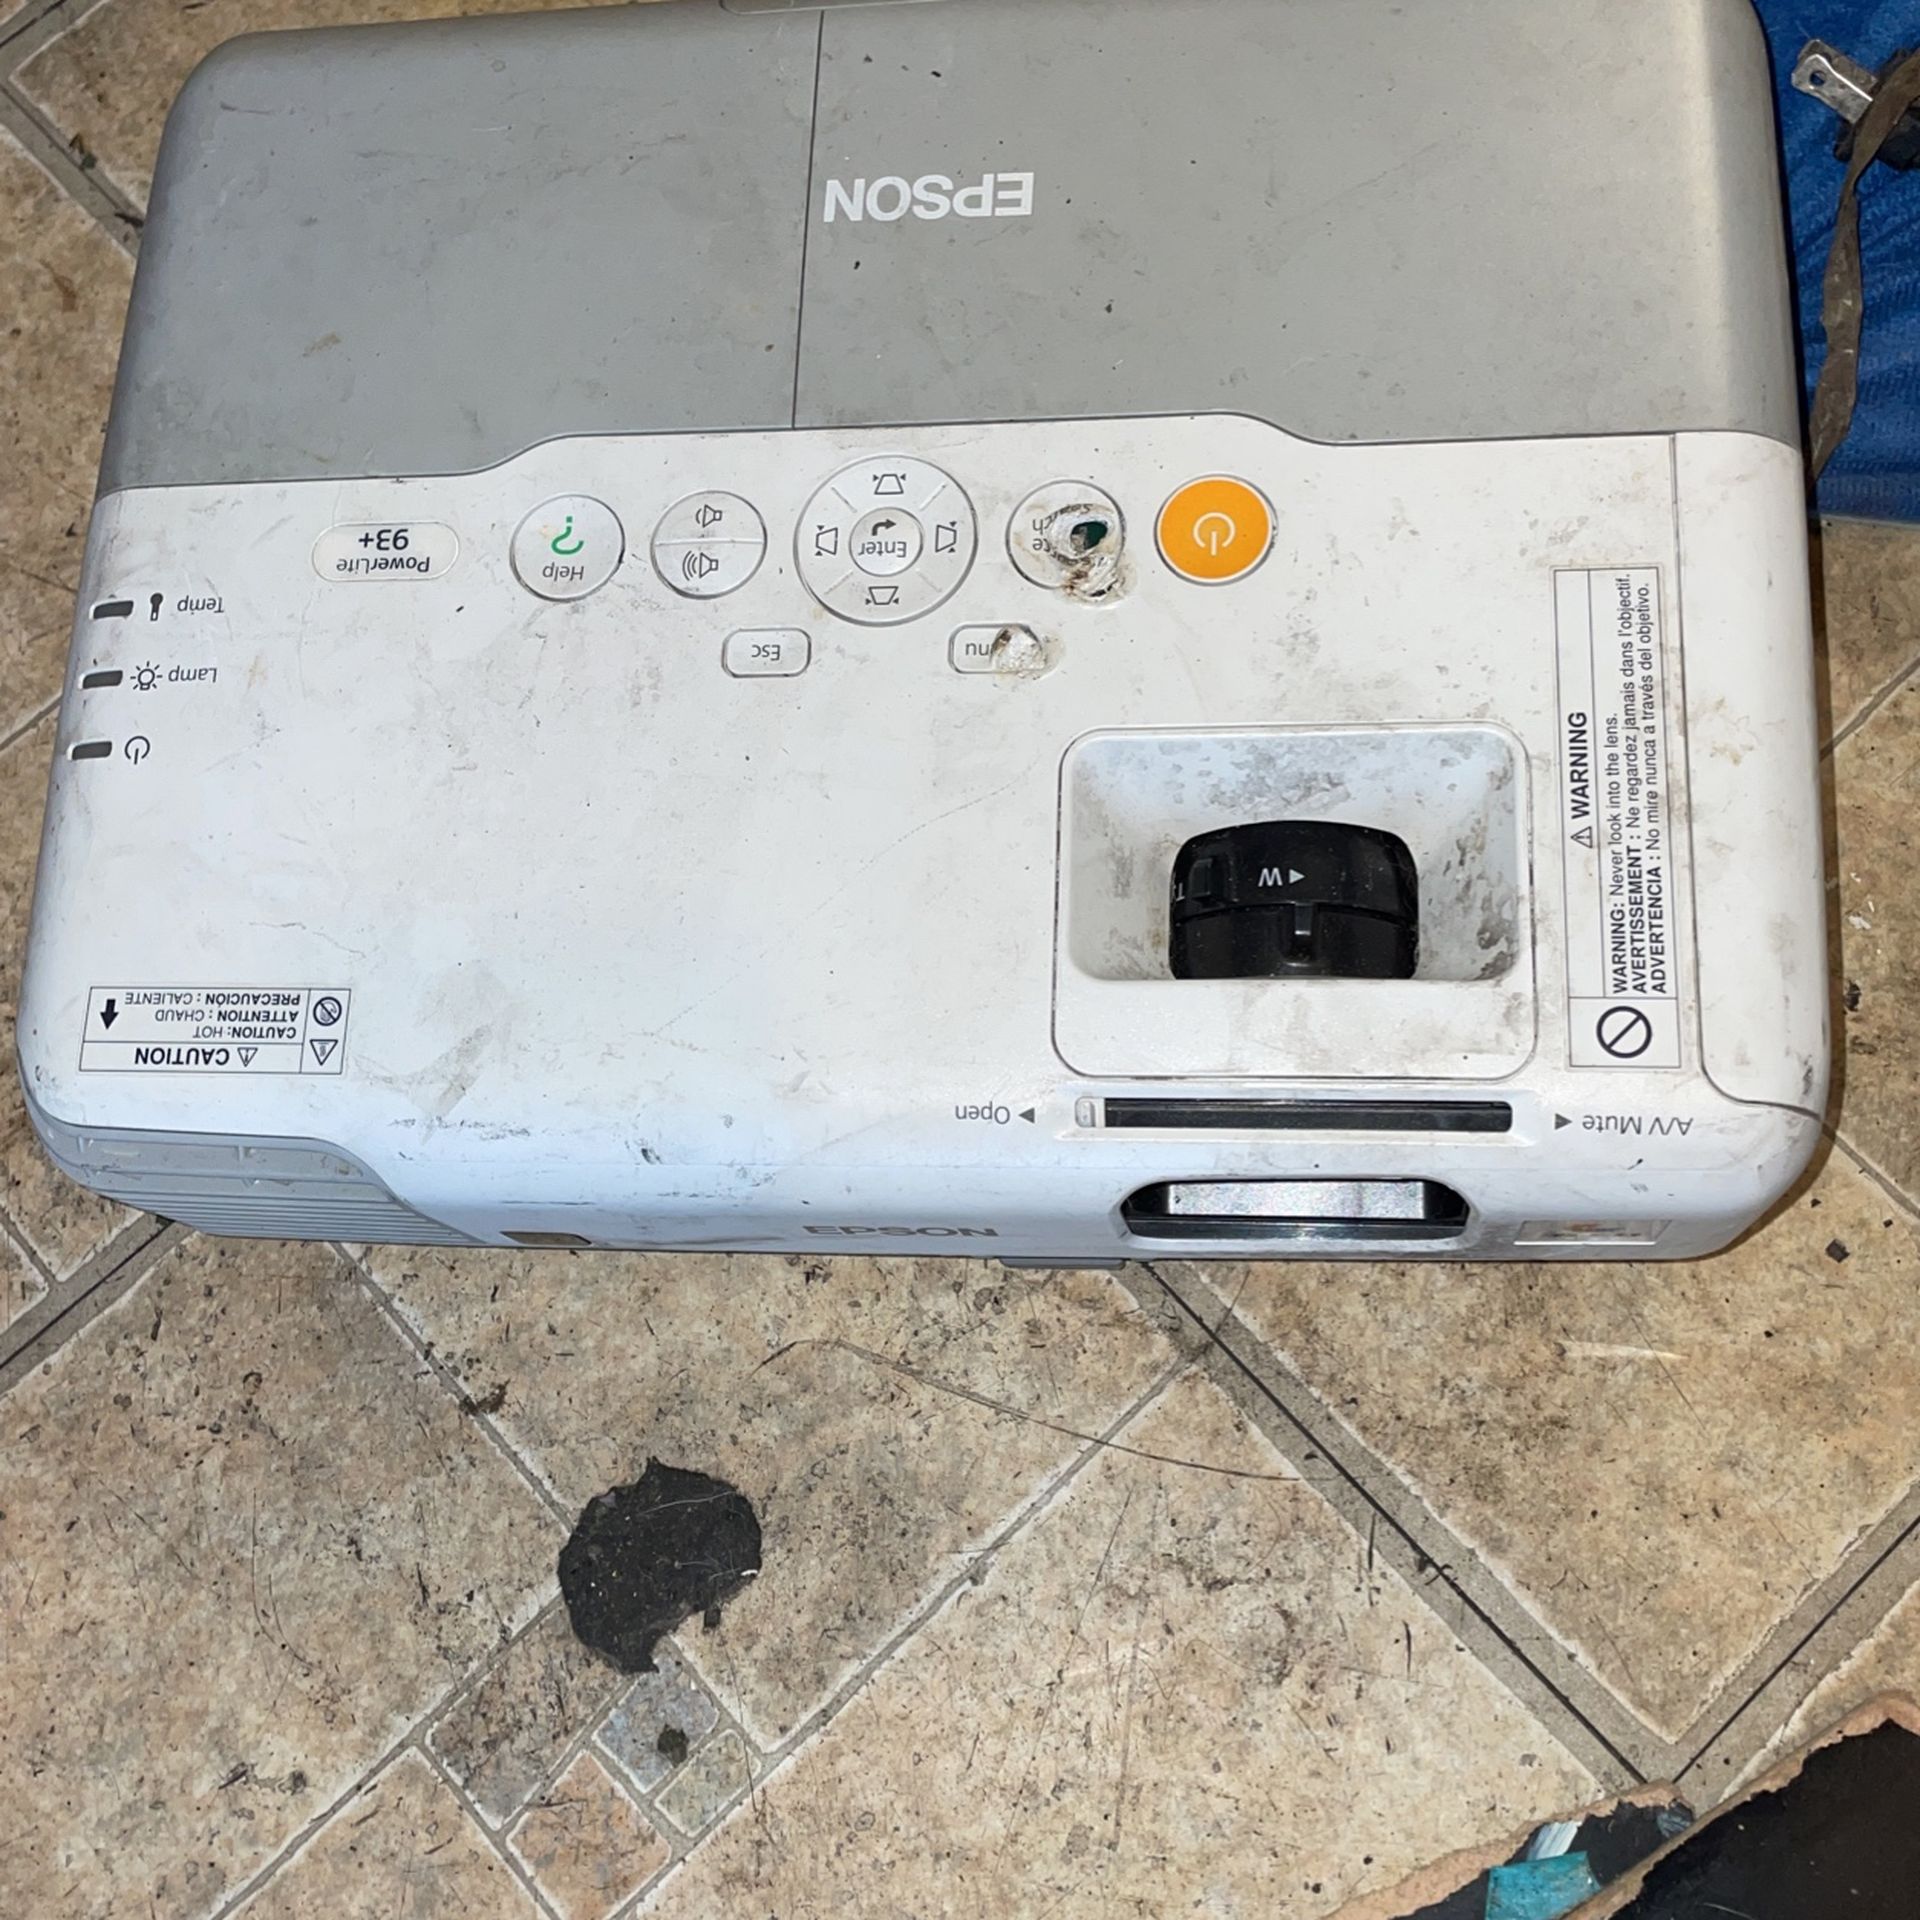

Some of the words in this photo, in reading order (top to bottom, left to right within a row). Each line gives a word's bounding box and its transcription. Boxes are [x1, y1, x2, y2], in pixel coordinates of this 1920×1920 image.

[823, 172, 1034, 222] EPSON
[358, 529, 409, 550] 93+
[858, 541, 907, 557] Enter
[336, 557, 430, 574] PowerLite
[542, 565, 584, 581] Help
[177, 595, 224, 613] Temp
[1615, 573, 1635, 637] l'objectif.
[1637, 583, 1654, 643] objetivo.
[751, 644, 781, 659] Esc
[1619, 641, 1635, 677] dans
[1638, 648, 1652, 671] del
[168, 665, 217, 683] Lamp
[1620, 682, 1640, 731] jamais
[1639, 675, 1654, 720] través
[1604, 713, 1618, 748] lens.
[1644, 725, 1656, 735] a
[1568, 712, 1590, 819] WARNING
[1604, 753, 1620, 777] the
[1623, 735, 1642, 801] regardez
[1644, 739, 1658, 785] nunca
[1606, 780, 1621, 809] into
[1626, 806, 1641, 828] Ne
[1643, 790, 1659, 823] mire
[1607, 812, 1622, 845] look
[1646, 828, 1660, 850] No
[1609, 850, 1624, 896] Never
[1626, 846, 1647, 994] AVERTISSEMENT
[1647, 866, 1667, 994] ADVERTENCIA
[1610, 903, 1627, 994] WARNING:
[125, 992, 194, 1005] CALIENTE
[205, 993, 301, 1008] PRECAUCIÓN
[155, 1009, 205, 1022] CHAUD
[217, 1010, 299, 1022] ATTENTION
[193, 1026, 223, 1038] HOT
[227, 1026, 297, 1039] CAUTION:
[134, 1047, 230, 1066] CAUTION
[955, 1101, 1010, 1125] Open
[1582, 1114, 1642, 1135] Mute
[1648, 1117, 1694, 1135] A/V
[802, 1225, 999, 1237] EPSON
